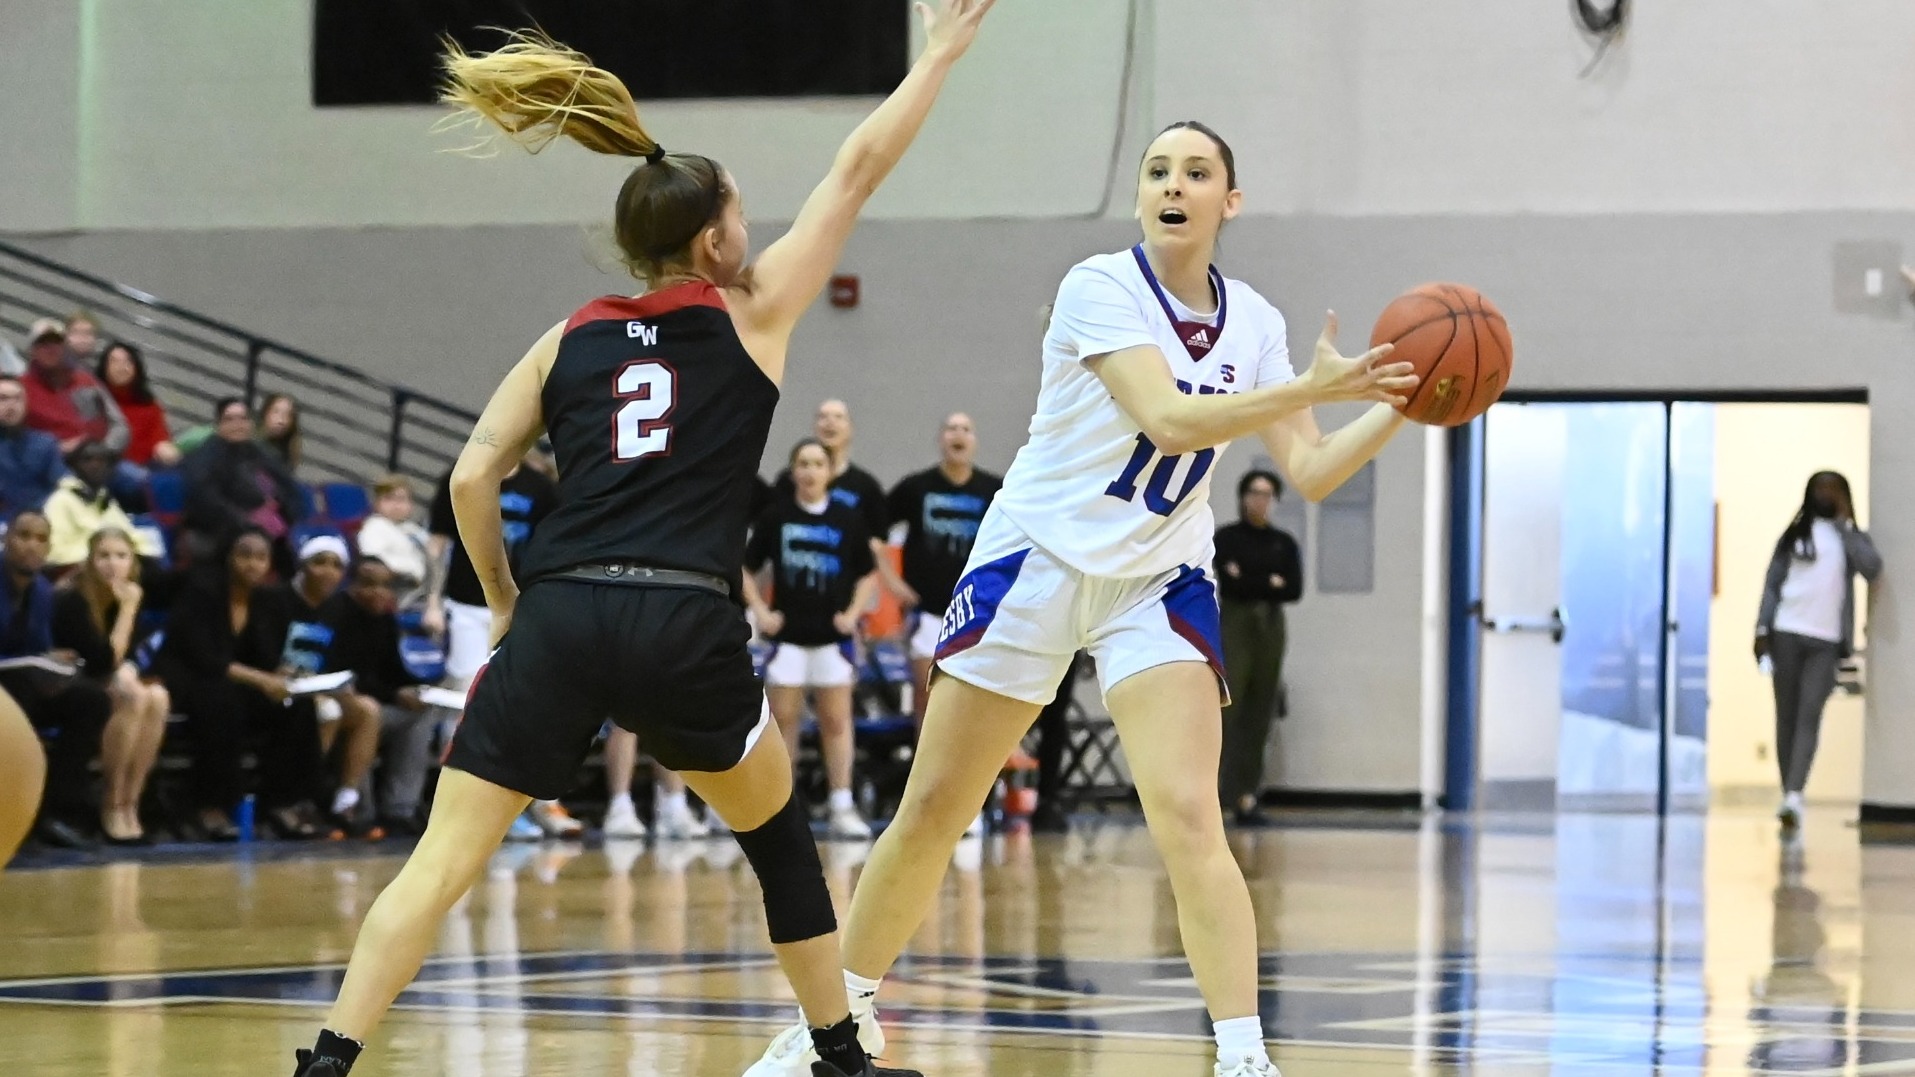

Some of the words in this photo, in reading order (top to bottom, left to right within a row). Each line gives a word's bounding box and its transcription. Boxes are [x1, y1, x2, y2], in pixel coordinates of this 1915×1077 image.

[627, 321, 659, 346] GW
[1186, 339, 1211, 350] adidas
[612, 358, 678, 463] 2
[1104, 431, 1215, 517] 10
